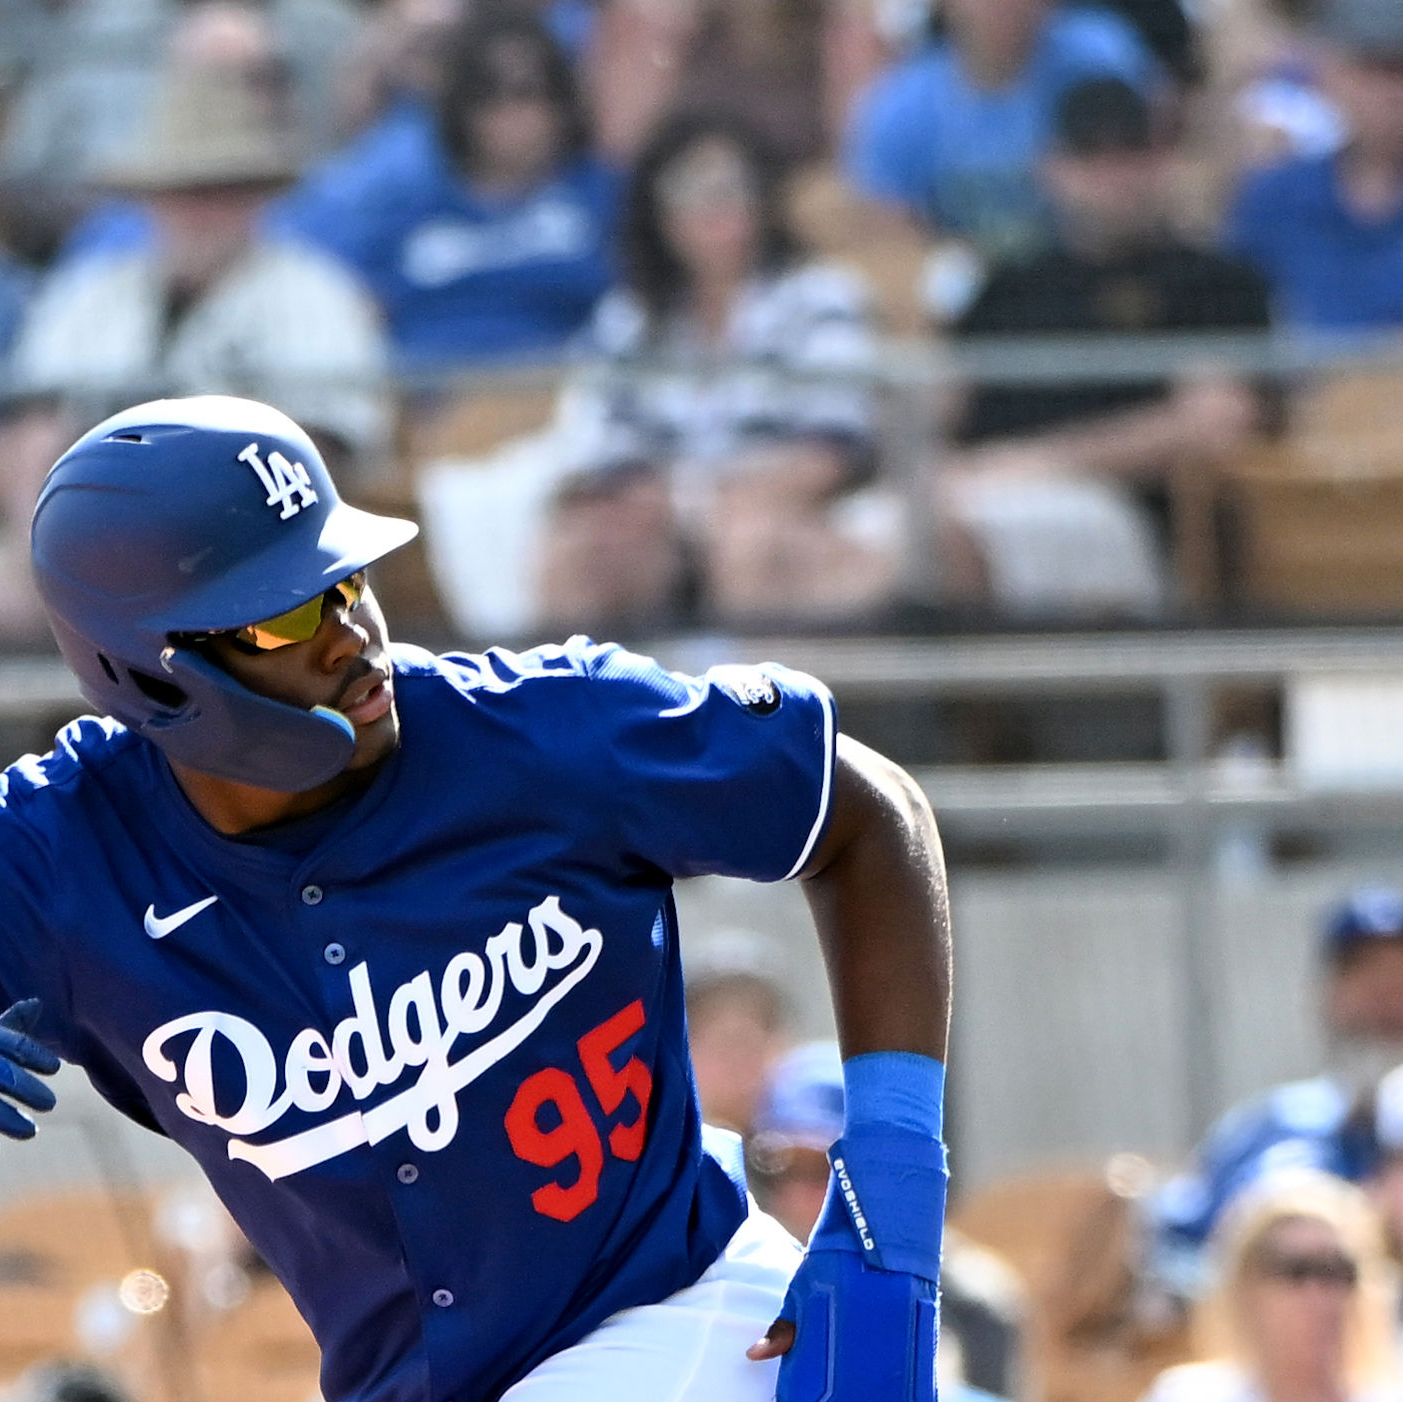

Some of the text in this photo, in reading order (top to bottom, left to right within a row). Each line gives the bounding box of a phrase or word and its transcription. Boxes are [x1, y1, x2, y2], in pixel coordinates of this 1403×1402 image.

[237, 442, 318, 520] LA
[142, 895, 604, 1182] Dodgers
[504, 999, 653, 1223] 95
